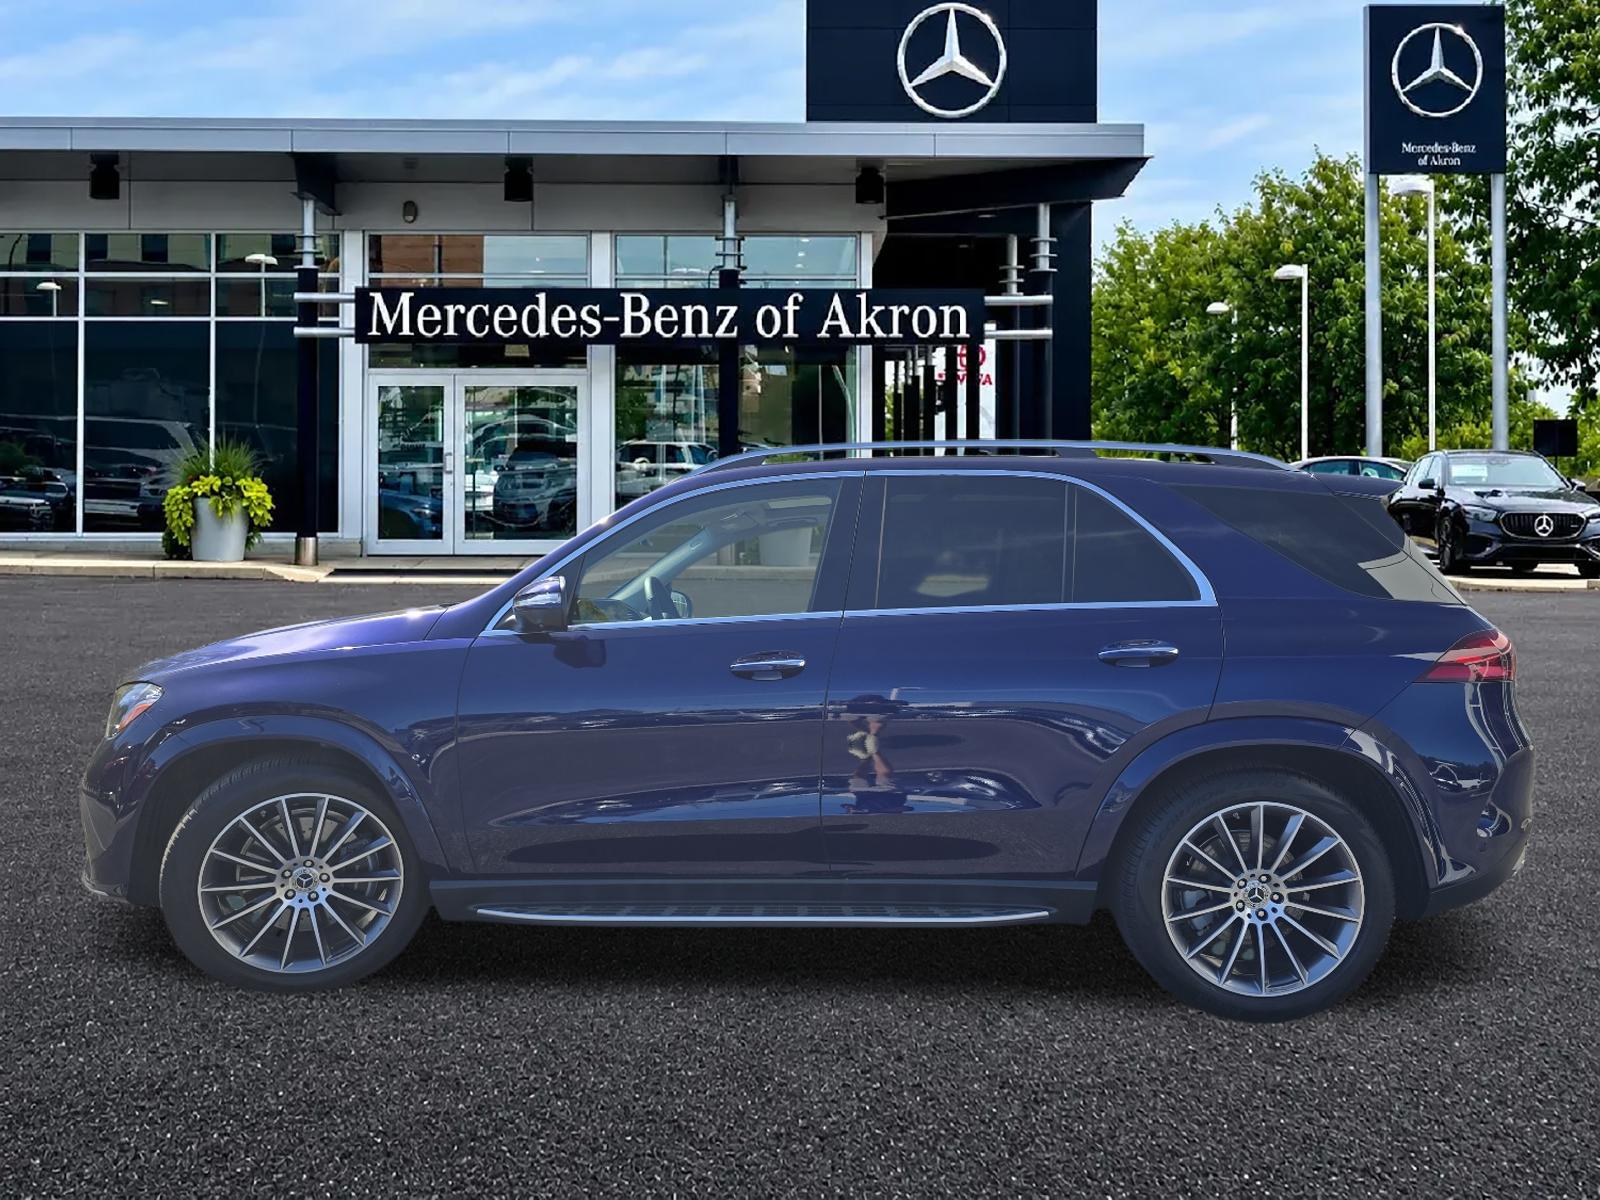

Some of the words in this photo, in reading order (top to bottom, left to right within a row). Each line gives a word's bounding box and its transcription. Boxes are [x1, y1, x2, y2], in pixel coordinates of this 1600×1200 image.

[1401, 141, 1477, 154] Mercedes-Benz
[1417, 154, 1429, 166] of
[1430, 154, 1461, 166] Akron
[367, 291, 738, 338] Mercedes-Benz
[755, 292, 804, 338] of
[816, 291, 971, 338] Akron
